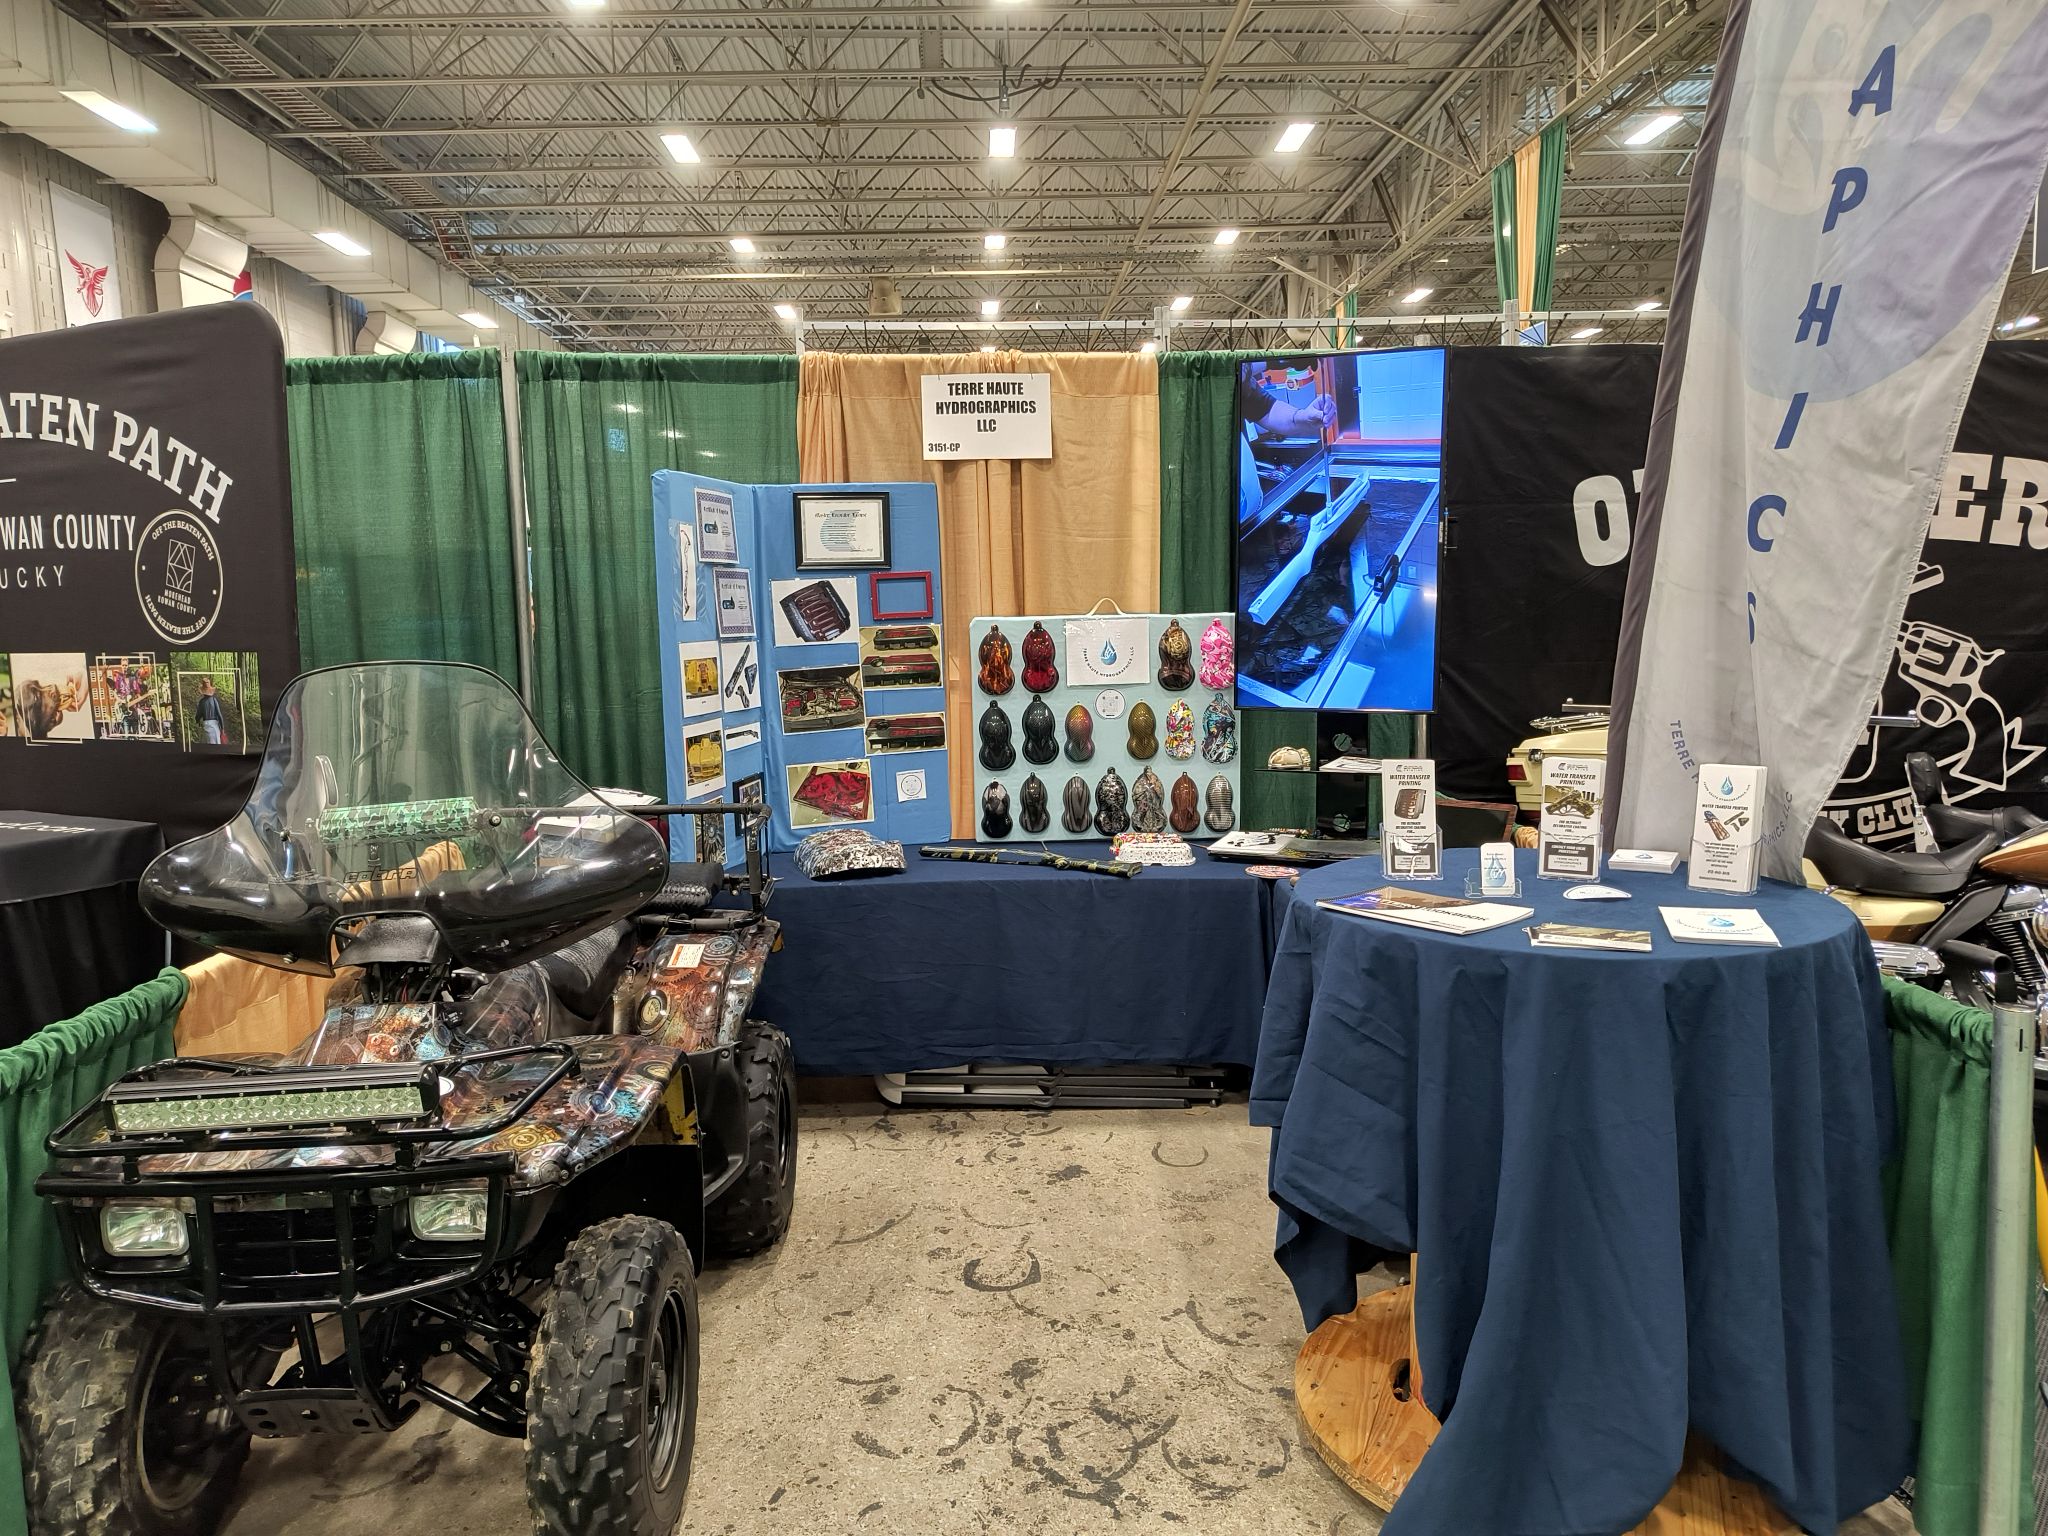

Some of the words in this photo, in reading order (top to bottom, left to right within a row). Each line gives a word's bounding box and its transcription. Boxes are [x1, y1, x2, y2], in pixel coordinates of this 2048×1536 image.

[947, 382, 984, 396] TERRE
[986, 381, 1024, 395] HAUTE
[935, 400, 1037, 415] HYDROGRAPHICS
[976, 419, 997, 432] LLC
[928, 442, 961, 452] 3151-CP
[108, 410, 233, 524] PATH
[53, 514, 136, 551] COUNTY
[151, 527, 164, 540] OFF
[162, 520, 177, 530] THE
[176, 520, 202, 540] BEATEN
[200, 537, 215, 561] PATH
[144, 594, 158, 618] PATH
[157, 595, 176, 608] ROWAN
[176, 601, 197, 615] COUNTY
[156, 615, 182, 635] BEATEN
[181, 624, 197, 635] THE
[195, 616, 207, 631] OFF
[1670, 720, 1695, 770] TERRE
[1856, 796, 1914, 835] CLU
